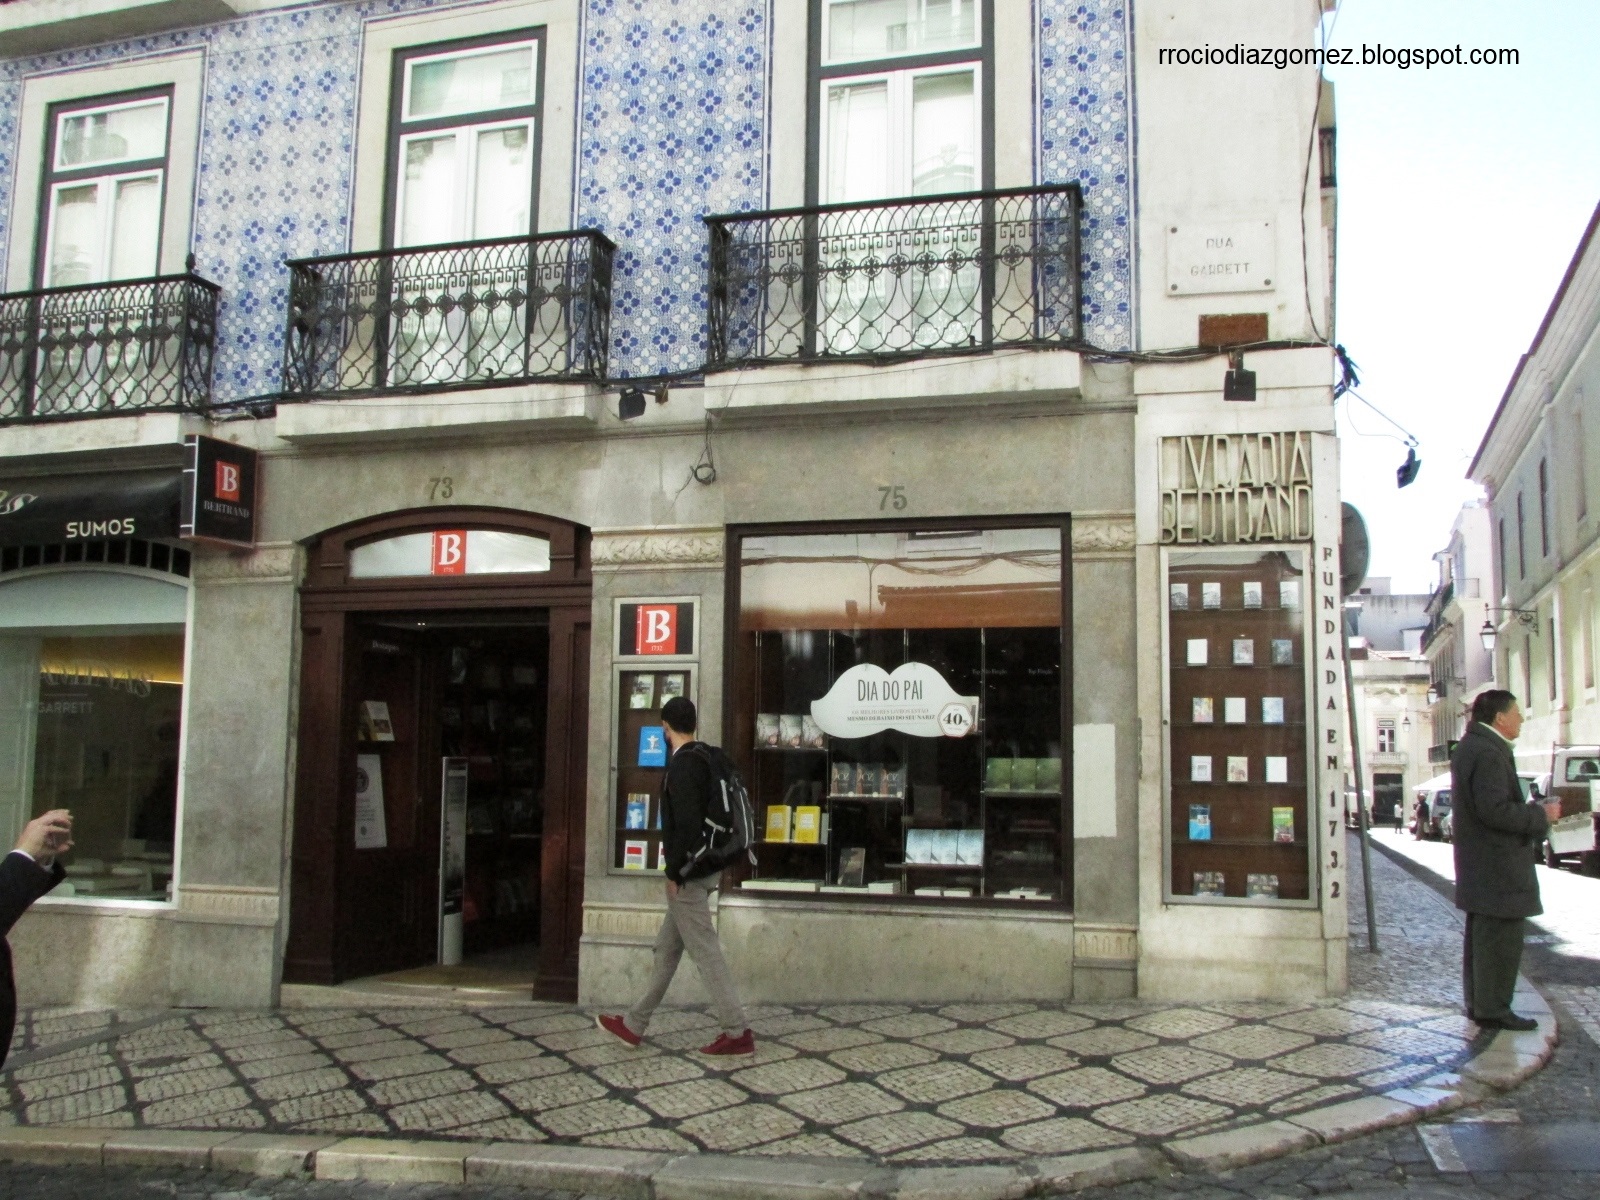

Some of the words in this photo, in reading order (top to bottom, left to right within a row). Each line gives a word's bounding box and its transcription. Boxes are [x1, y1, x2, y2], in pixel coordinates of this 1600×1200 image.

[1206, 237, 1234, 249] RUA
[1190, 262, 1251, 277] GARRETT
[1158, 431, 1312, 489] LIVRARIA
[222, 465, 238, 492] B
[429, 476, 453, 500] 73
[203, 500, 250, 519] BERTRAND
[877, 485, 908, 511] 75
[1160, 484, 1314, 544] BERTRAND
[65, 518, 135, 538] SUMOS
[438, 533, 461, 566] B
[645, 609, 671, 643] B
[1323, 547, 1337, 711] FUNDADA
[857, 679, 878, 701] DIA
[882, 680, 900, 701] DO
[903, 679, 923, 700] PAI
[1327, 729, 1338, 771] EM
[1329, 790, 1341, 899] 1732
